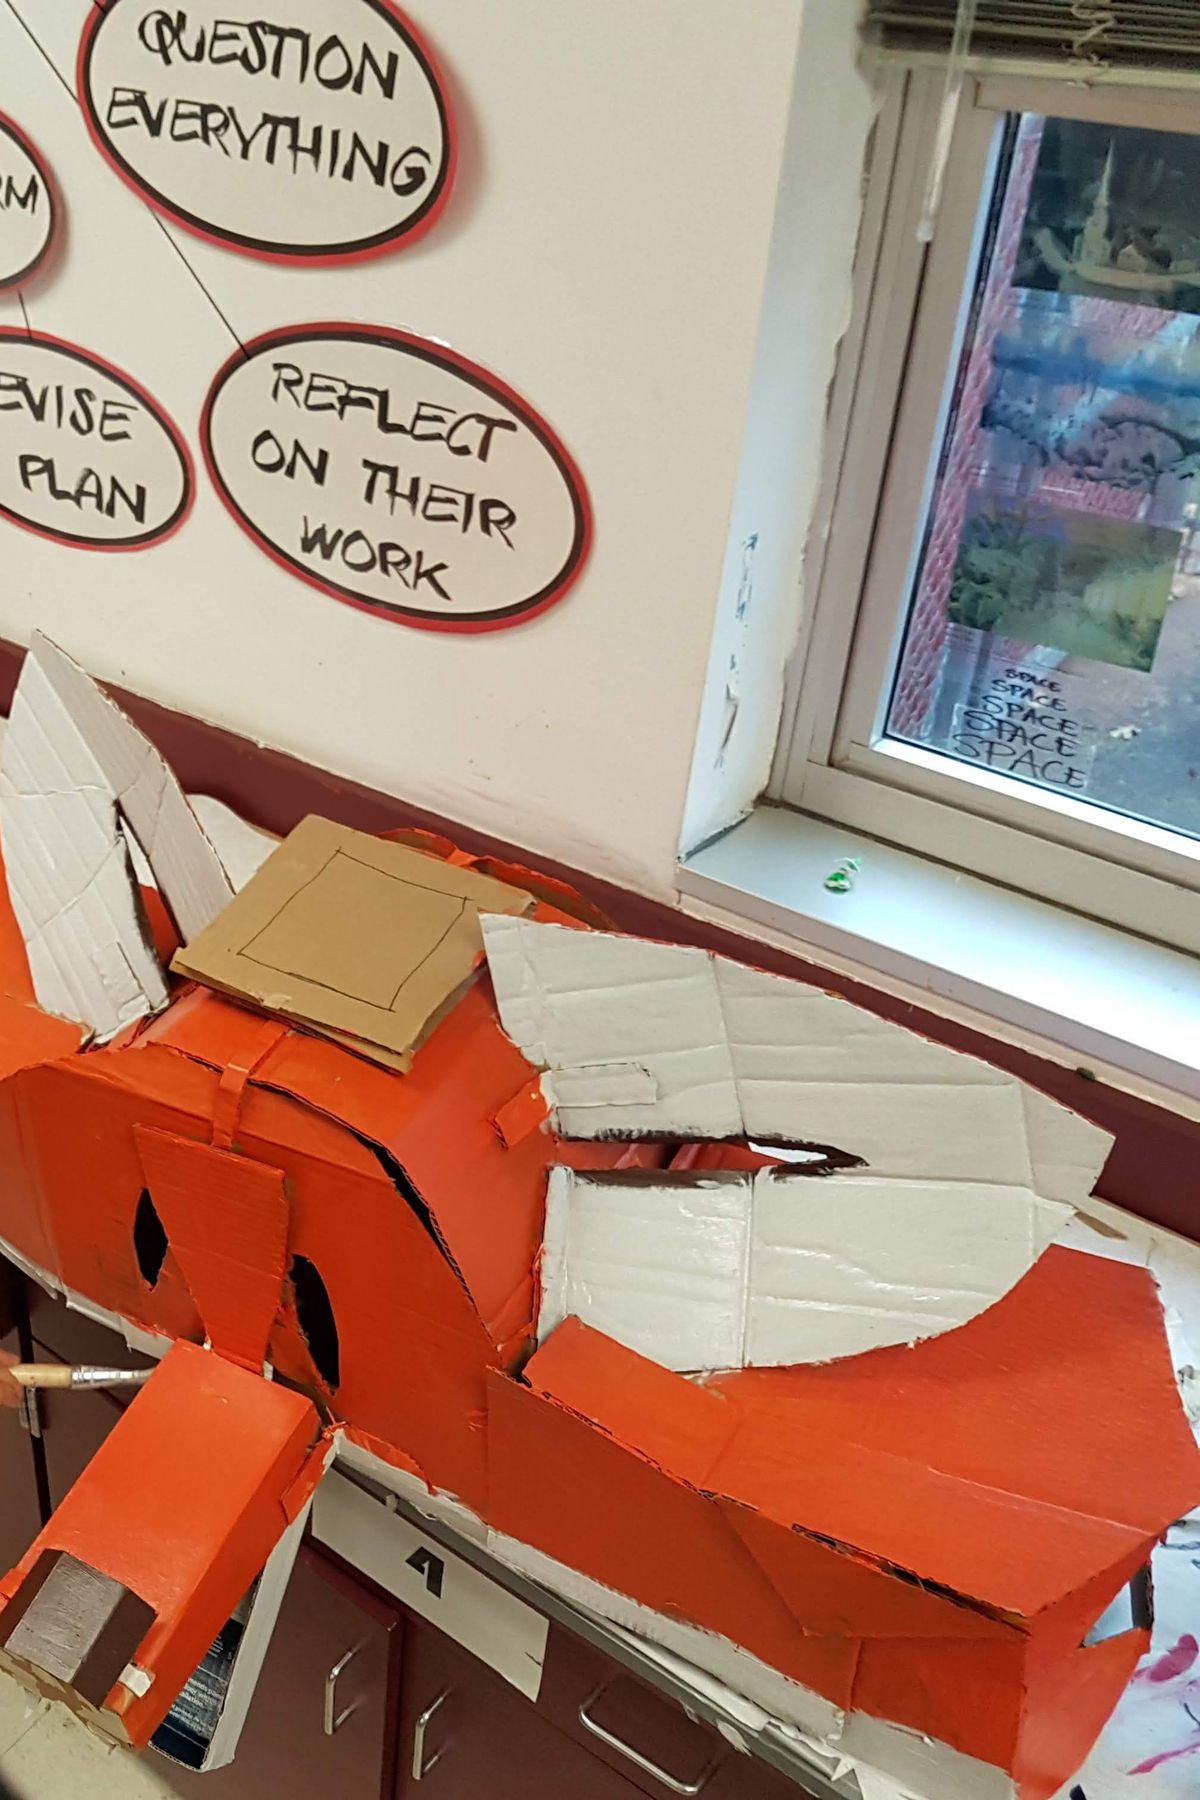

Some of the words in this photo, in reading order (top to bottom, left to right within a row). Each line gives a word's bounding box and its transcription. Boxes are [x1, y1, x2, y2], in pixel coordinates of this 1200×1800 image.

[138, 9, 399, 100] QUESTION
[106, 87, 431, 196] EVERYTHING
[271, 362, 517, 463] REFLECT
[18, 453, 147, 524] PLAN
[250, 430, 328, 487] ON
[360, 458, 517, 550] THEIR
[299, 516, 453, 601] WORK
[991, 678, 1067, 712] SPACE
[1005, 668, 1061, 693] SPACE
[963, 709, 1076, 757] SPACE
[982, 695, 1079, 738] SPACE
[952, 734, 1087, 789] SPACE
